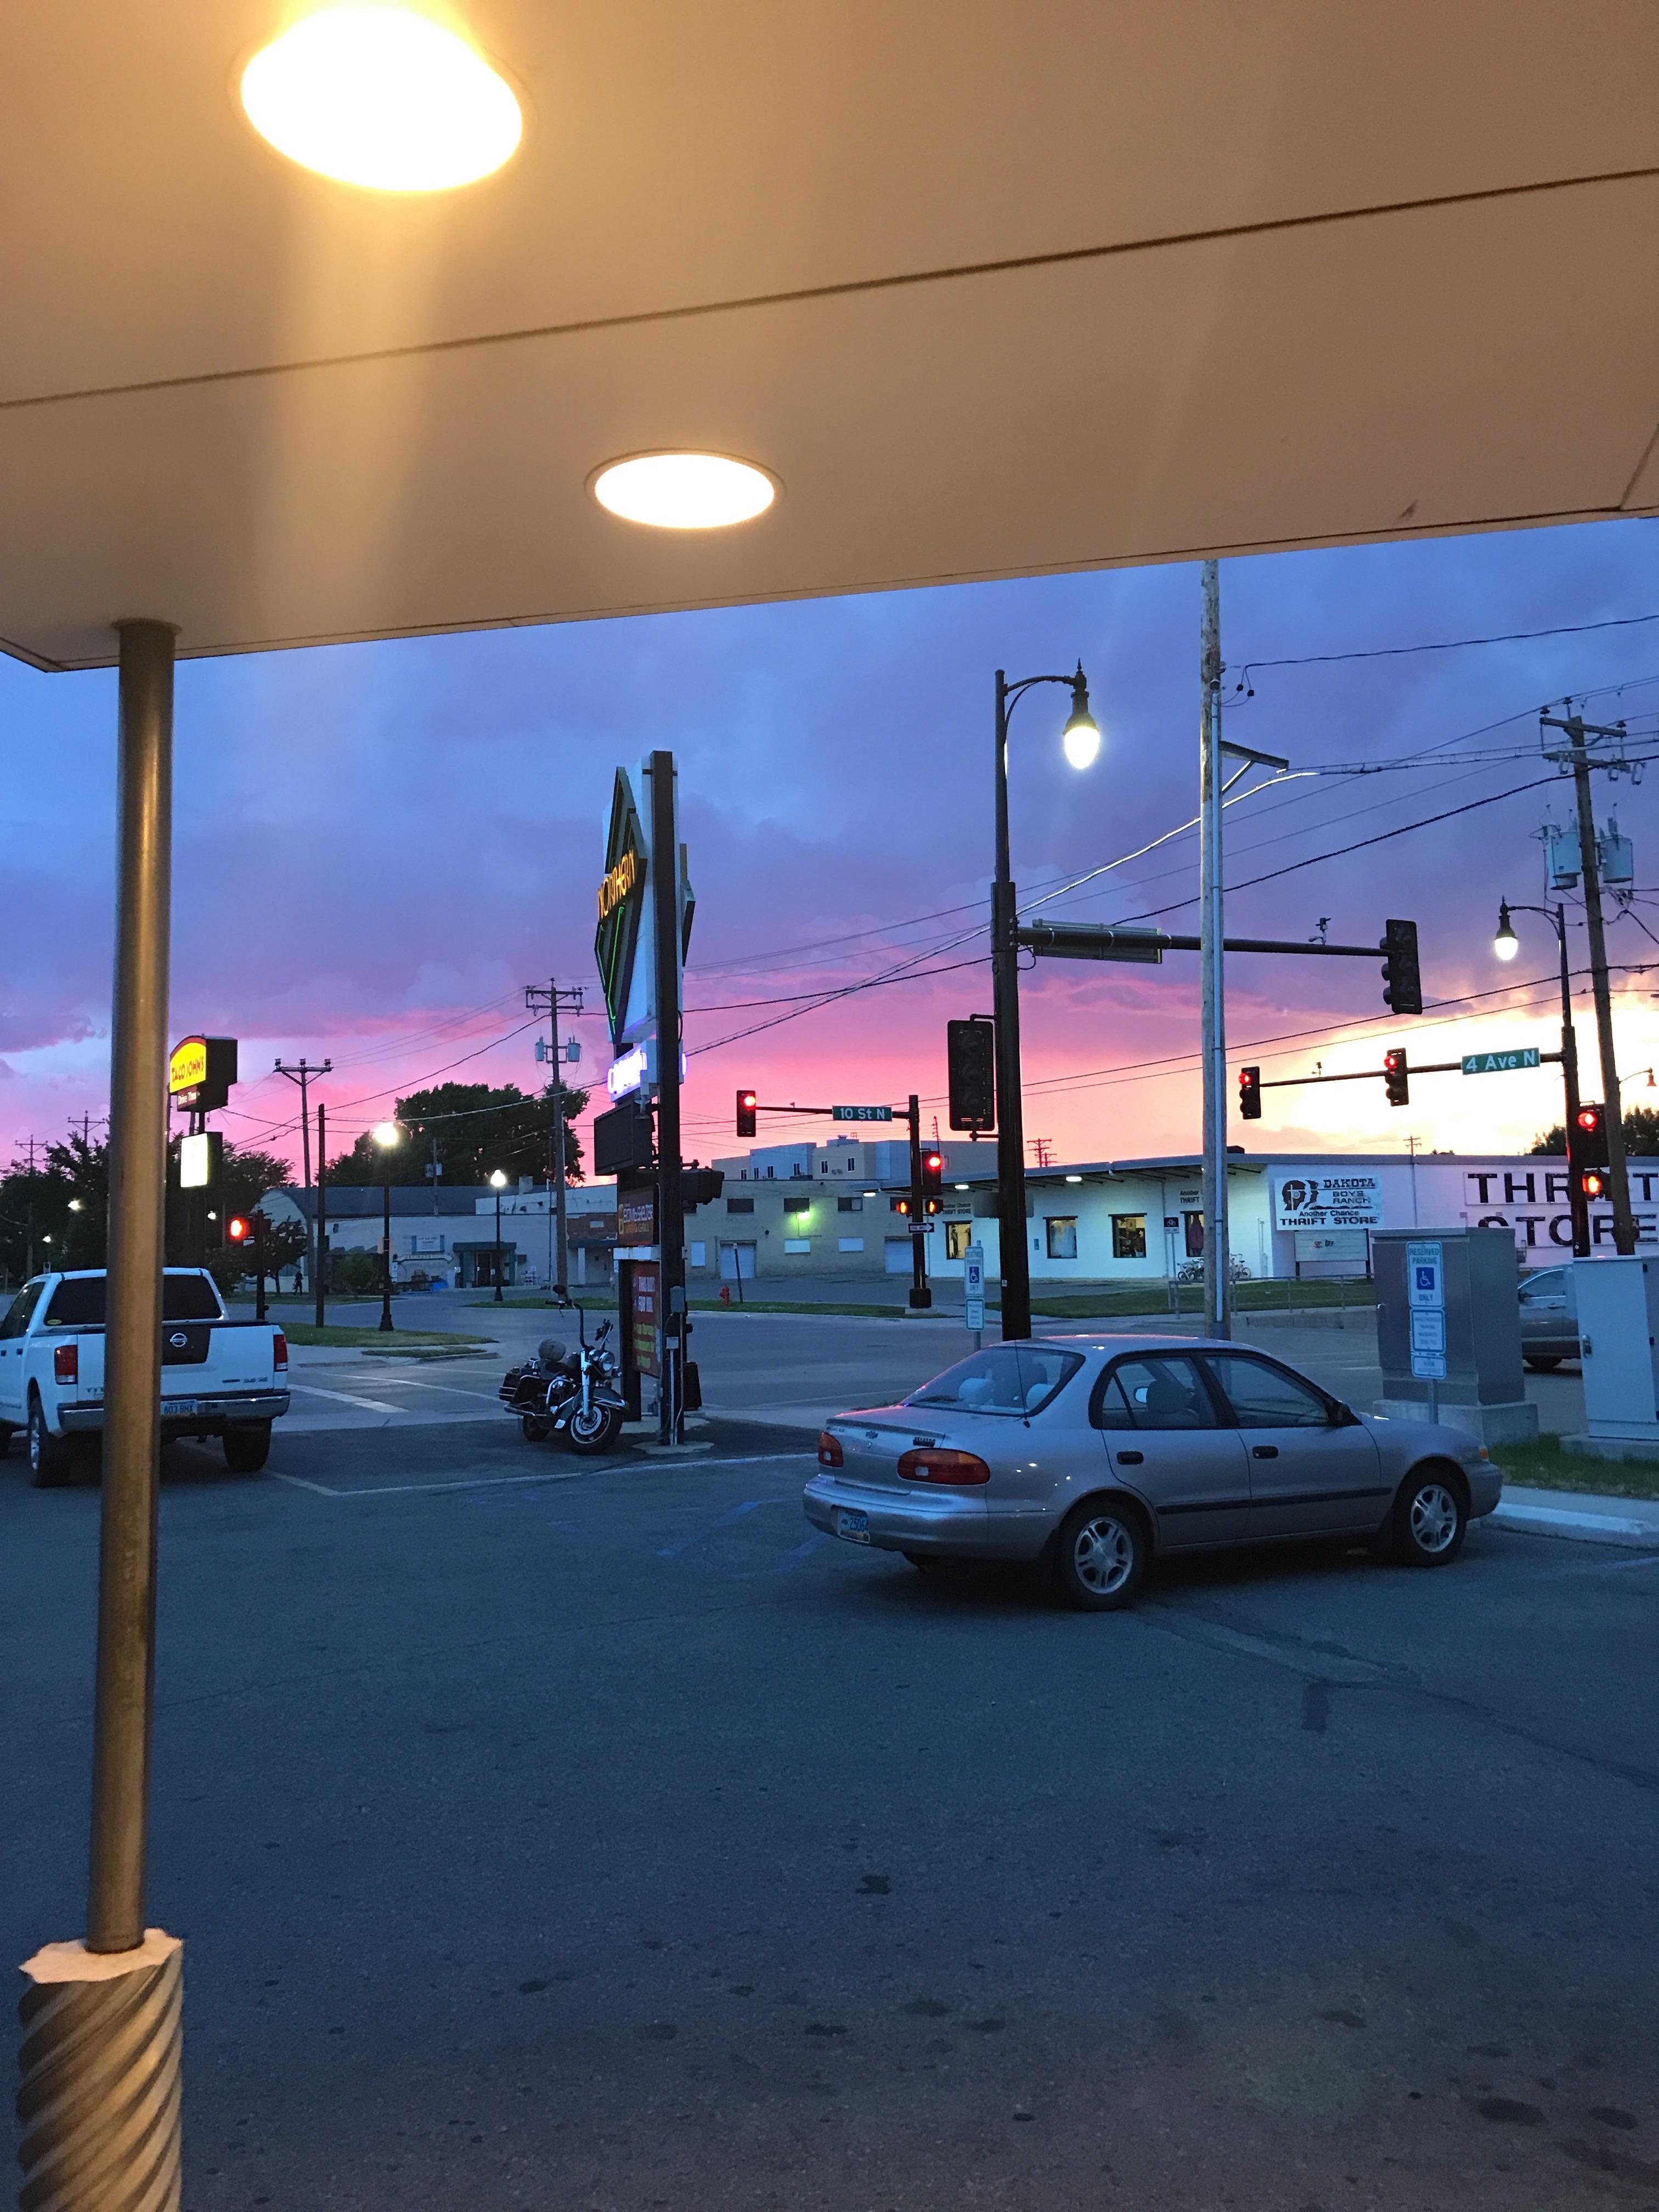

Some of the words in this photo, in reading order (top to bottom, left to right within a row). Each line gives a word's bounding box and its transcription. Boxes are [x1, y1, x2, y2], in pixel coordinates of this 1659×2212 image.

[1466, 1057, 1477, 1071] 4
[1485, 1055, 1517, 1070] Ave
[1523, 1050, 1536, 1066] N
[172, 1063, 185, 1083] TACO
[840, 1107, 854, 1120] 10
[857, 1108, 872, 1120] St
[876, 1108, 885, 1120] N
[1323, 1178, 1375, 1188] DAKOTA
[1468, 1172, 1659, 1204] THRT
[1279, 1217, 1327, 1226] THRIFT
[1334, 1216, 1378, 1224] STORE
[1412, 1256, 1438, 1265] PARKING
